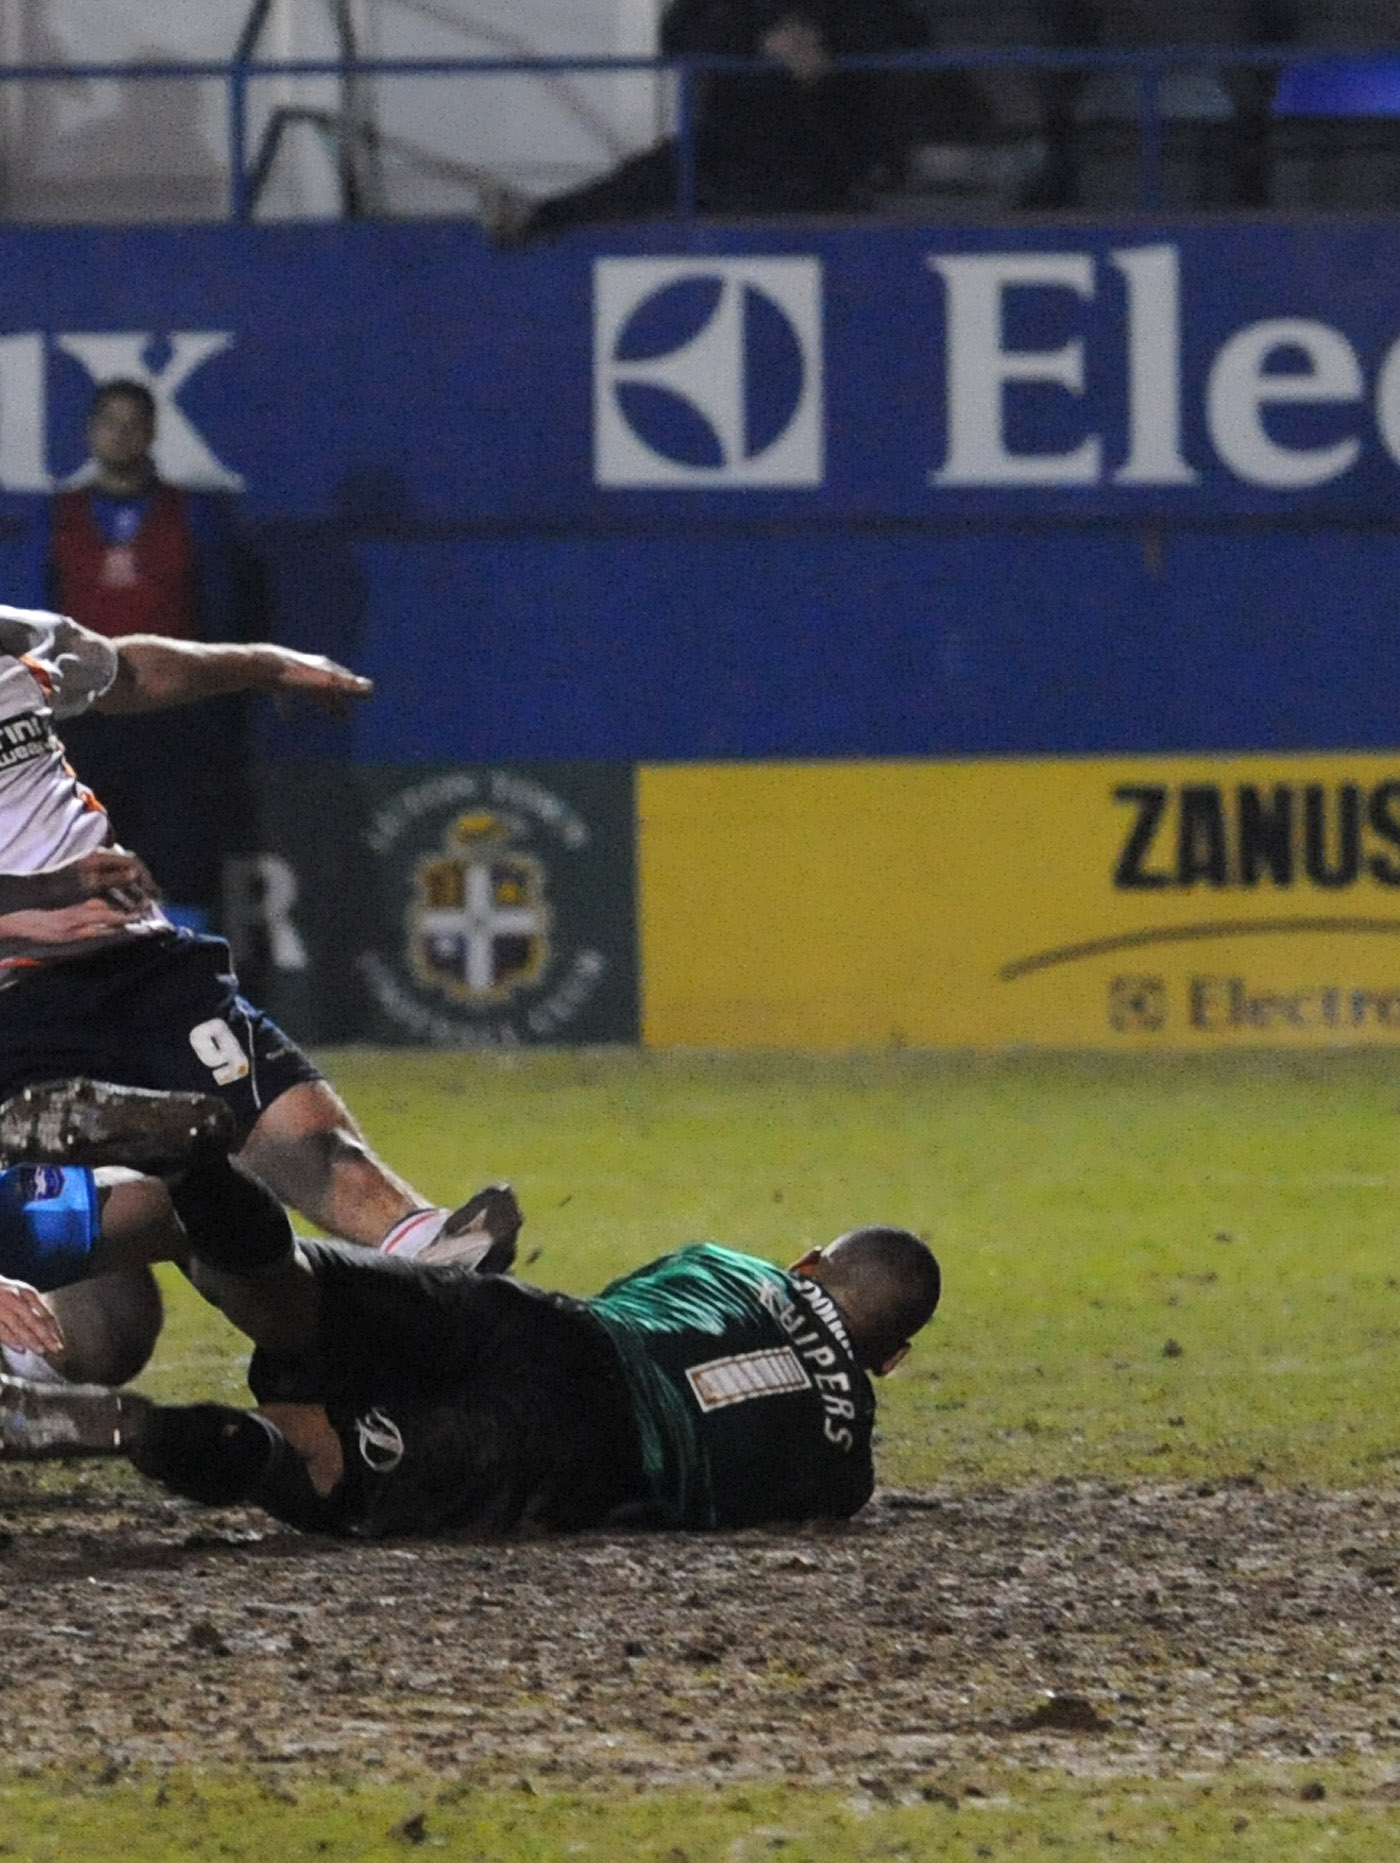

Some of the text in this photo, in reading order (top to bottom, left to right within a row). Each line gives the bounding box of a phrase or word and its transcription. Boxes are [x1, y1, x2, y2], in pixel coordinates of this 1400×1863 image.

[927, 245, 1400, 488] Ele
[1113, 778, 1400, 890] ZANUS
[189, 1017, 250, 1086] 9
